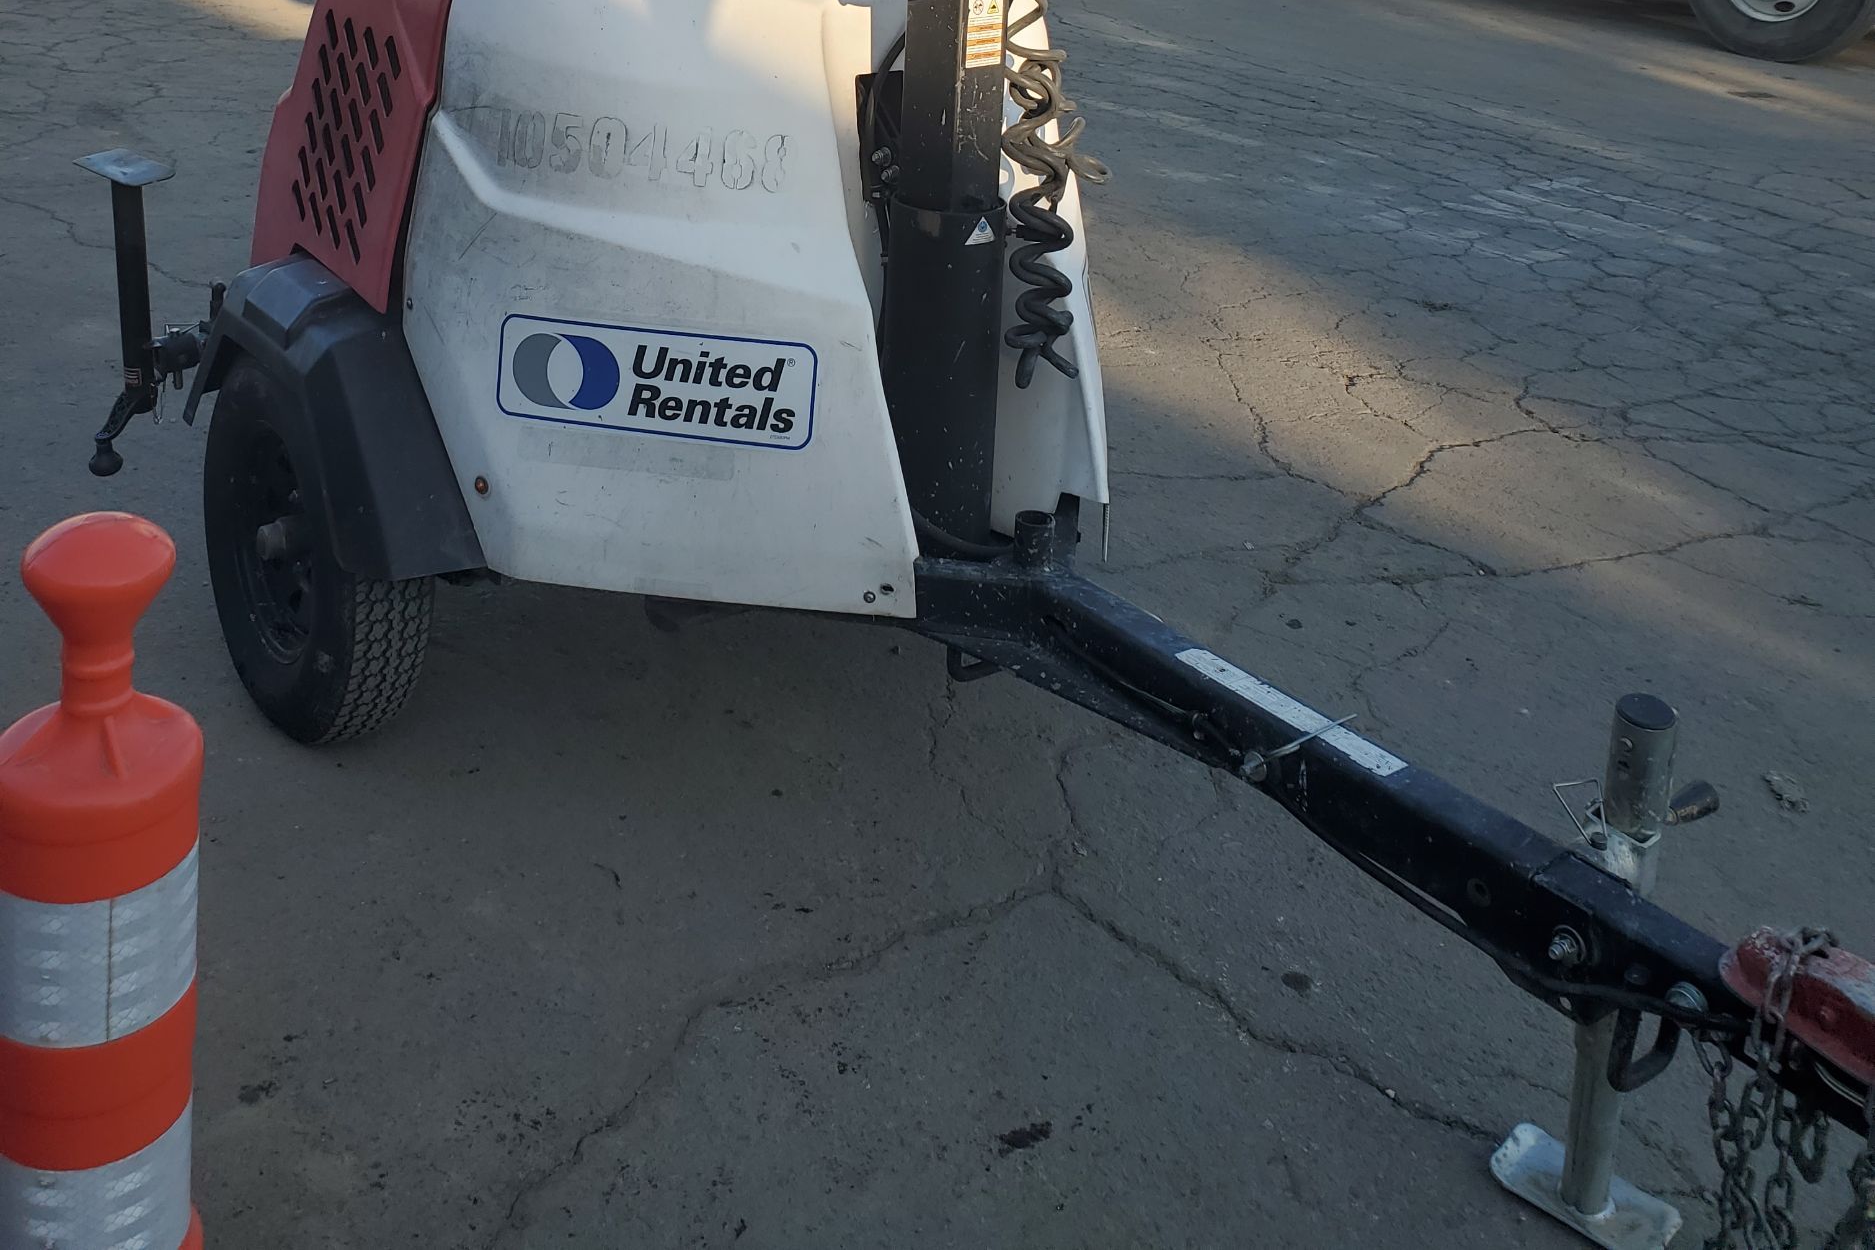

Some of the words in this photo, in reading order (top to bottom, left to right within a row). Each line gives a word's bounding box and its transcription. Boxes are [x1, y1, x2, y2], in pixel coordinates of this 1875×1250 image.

[496, 108, 792, 194] 10504468
[631, 344, 787, 392] United
[627, 383, 796, 433] Rentals
